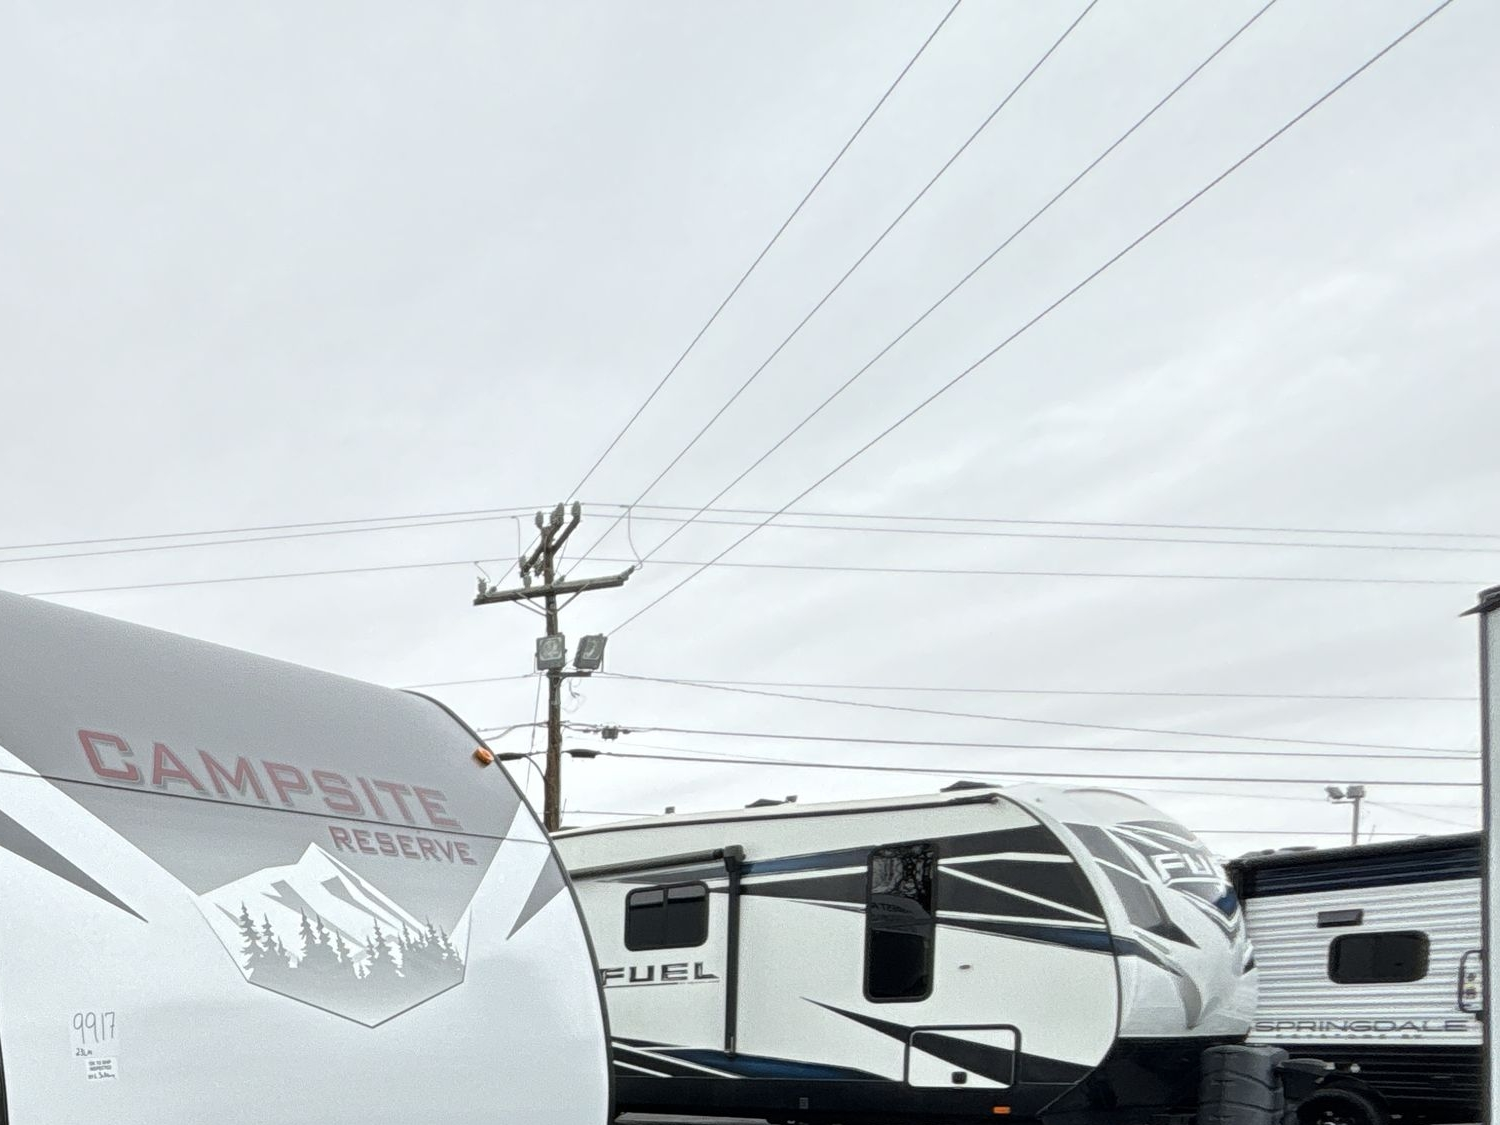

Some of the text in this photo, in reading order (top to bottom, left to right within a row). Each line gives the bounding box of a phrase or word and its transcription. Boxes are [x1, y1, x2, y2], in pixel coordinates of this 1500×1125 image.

[77, 728, 463, 830] CAMPSITE
[327, 825, 478, 867] RESERVE
[600, 961, 719, 986] FUEL
[73, 1011, 115, 1044] 9917
[1255, 1020, 1469, 1032] SPRINGDALE
